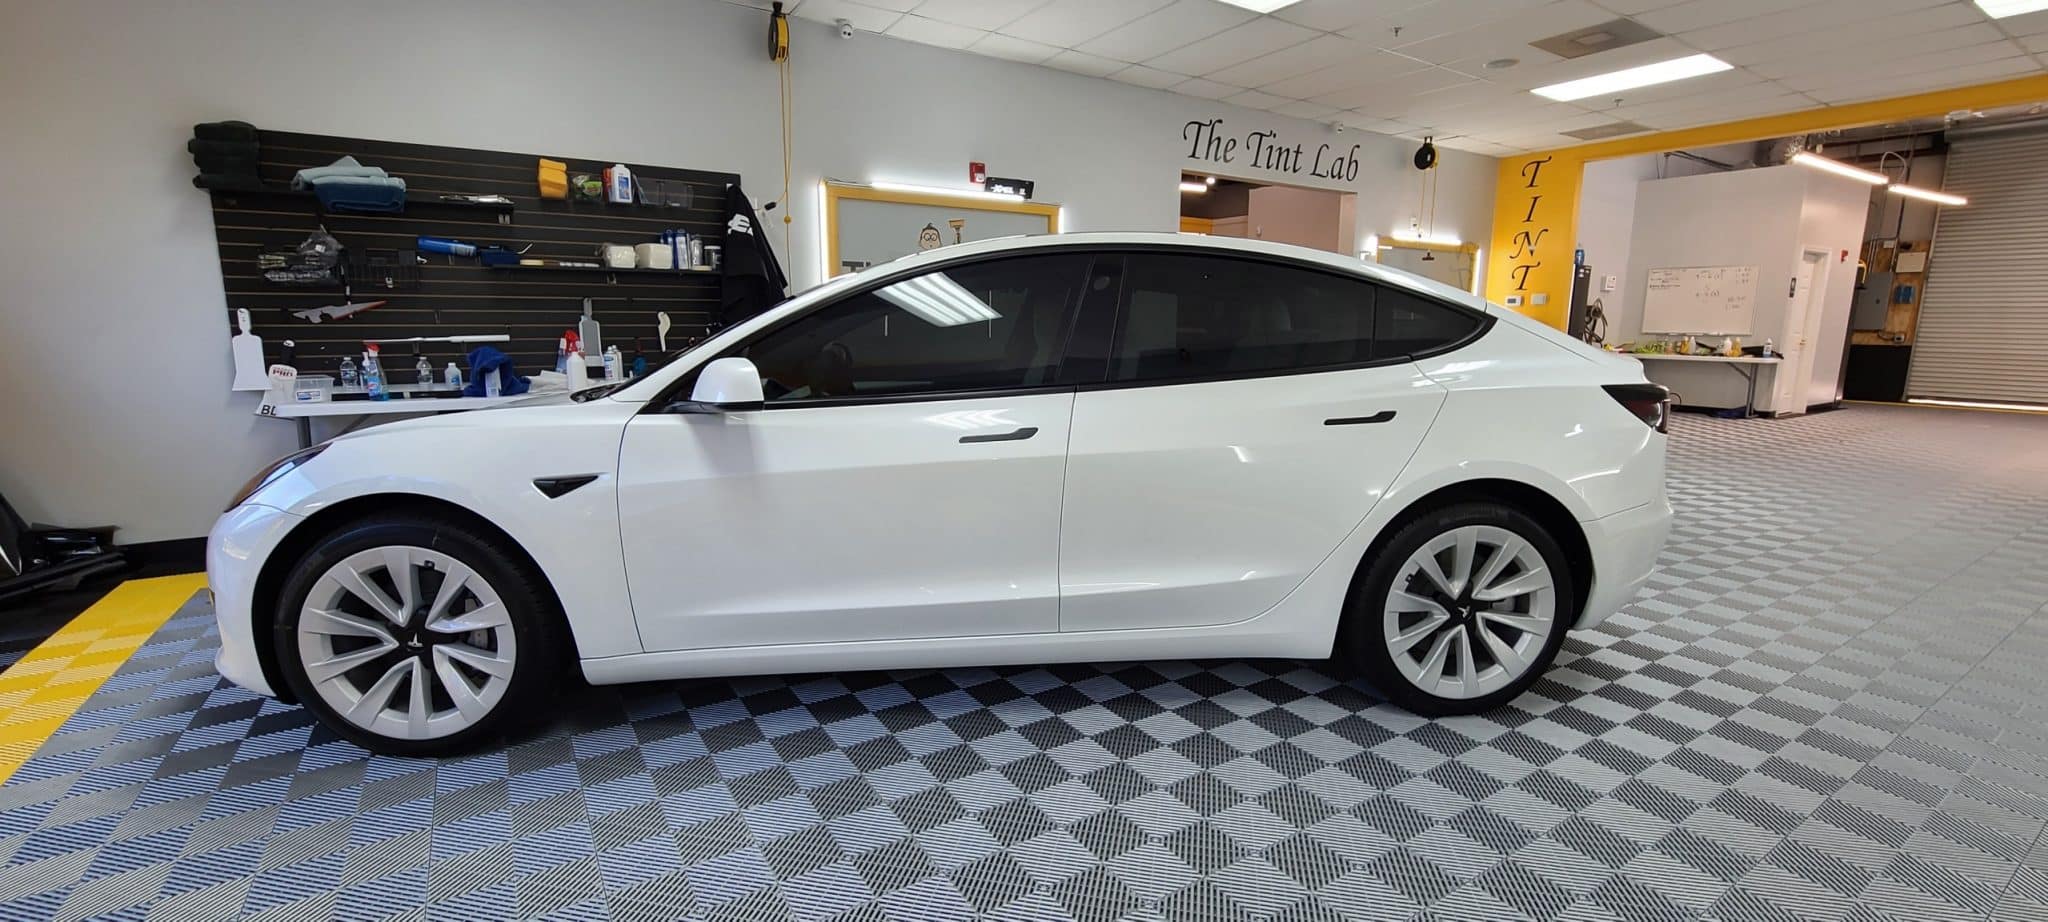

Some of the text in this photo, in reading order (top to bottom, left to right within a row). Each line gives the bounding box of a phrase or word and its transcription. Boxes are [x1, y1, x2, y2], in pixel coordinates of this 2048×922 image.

[1183, 119, 1361, 182] The Tint Lab
[1509, 156, 1552, 291] TINT
